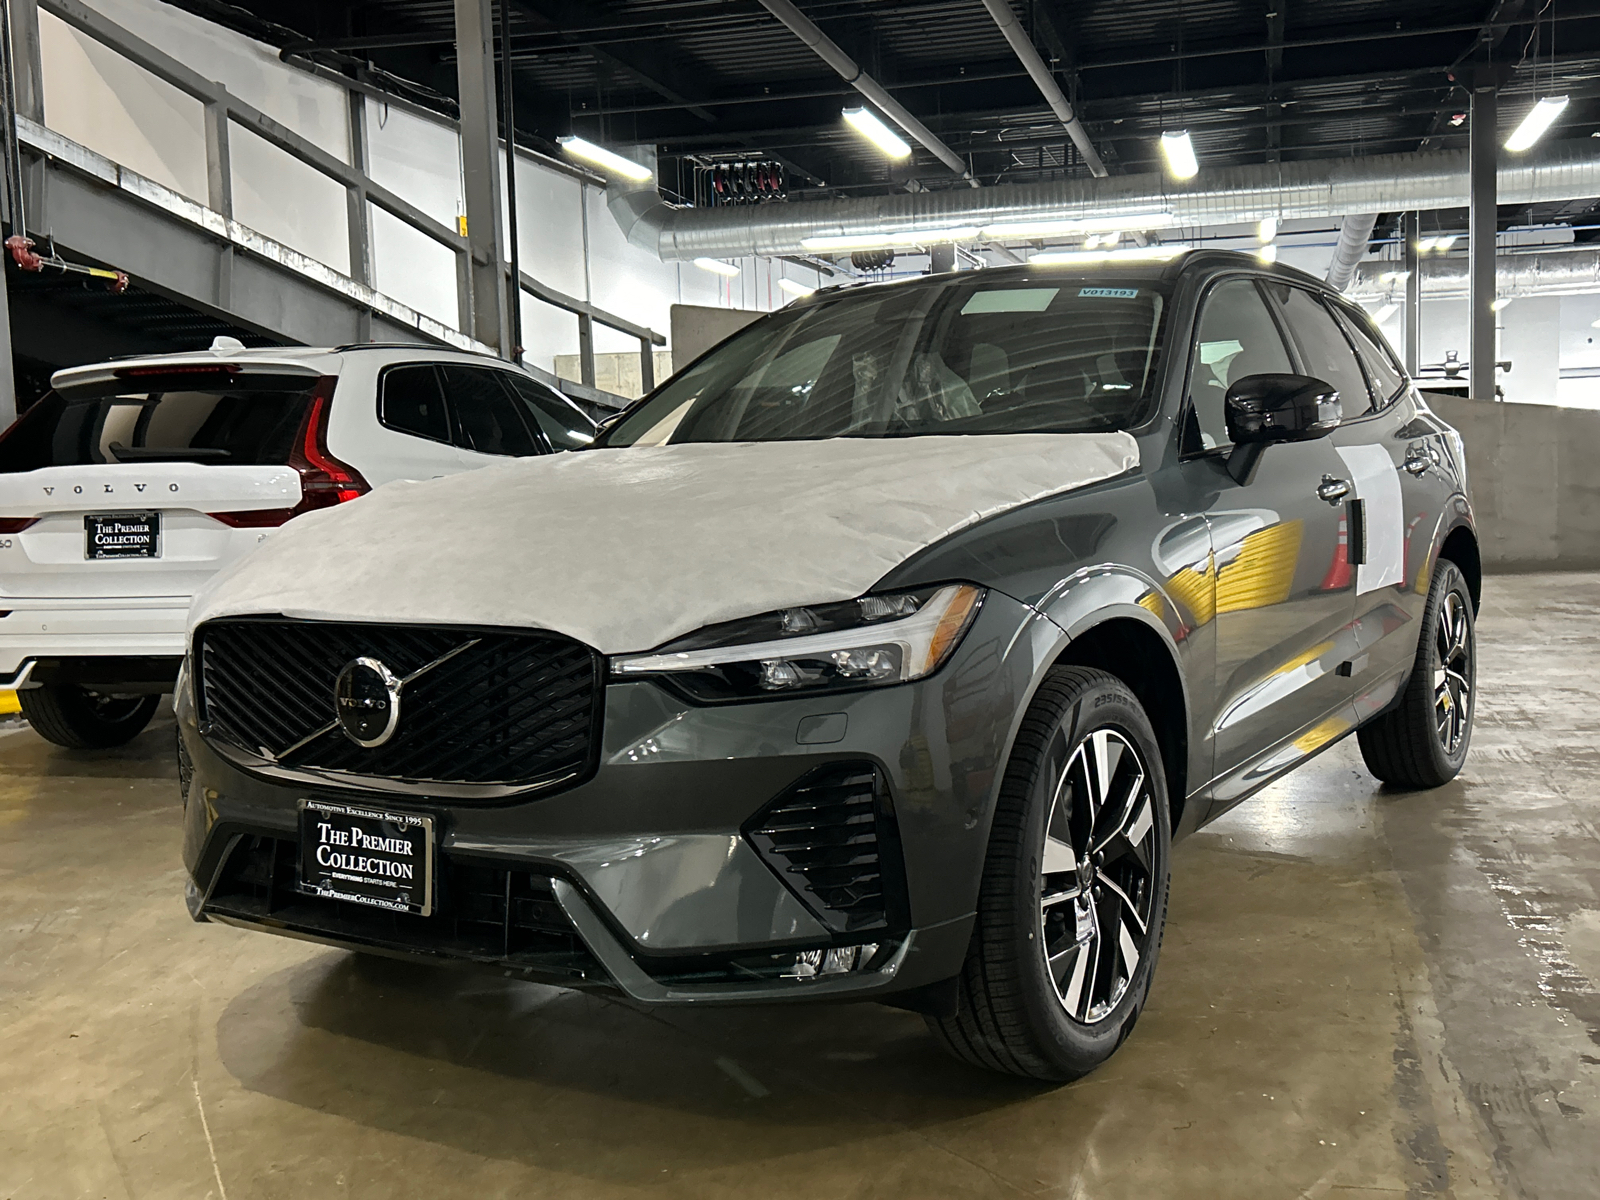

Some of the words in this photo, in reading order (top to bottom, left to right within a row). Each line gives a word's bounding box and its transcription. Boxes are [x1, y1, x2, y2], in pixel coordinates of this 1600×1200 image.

[43, 483, 179, 496] VOLVO
[95, 523, 114, 534] THE
[114, 522, 150, 533] PREMIER
[95, 534, 150, 545] COLLECTION
[339, 697, 387, 710] VOLVO
[405, 816, 422, 826] 1995
[317, 822, 349, 847] THE
[350, 827, 413, 856] PREMIER
[316, 845, 413, 879] COLLECTION
